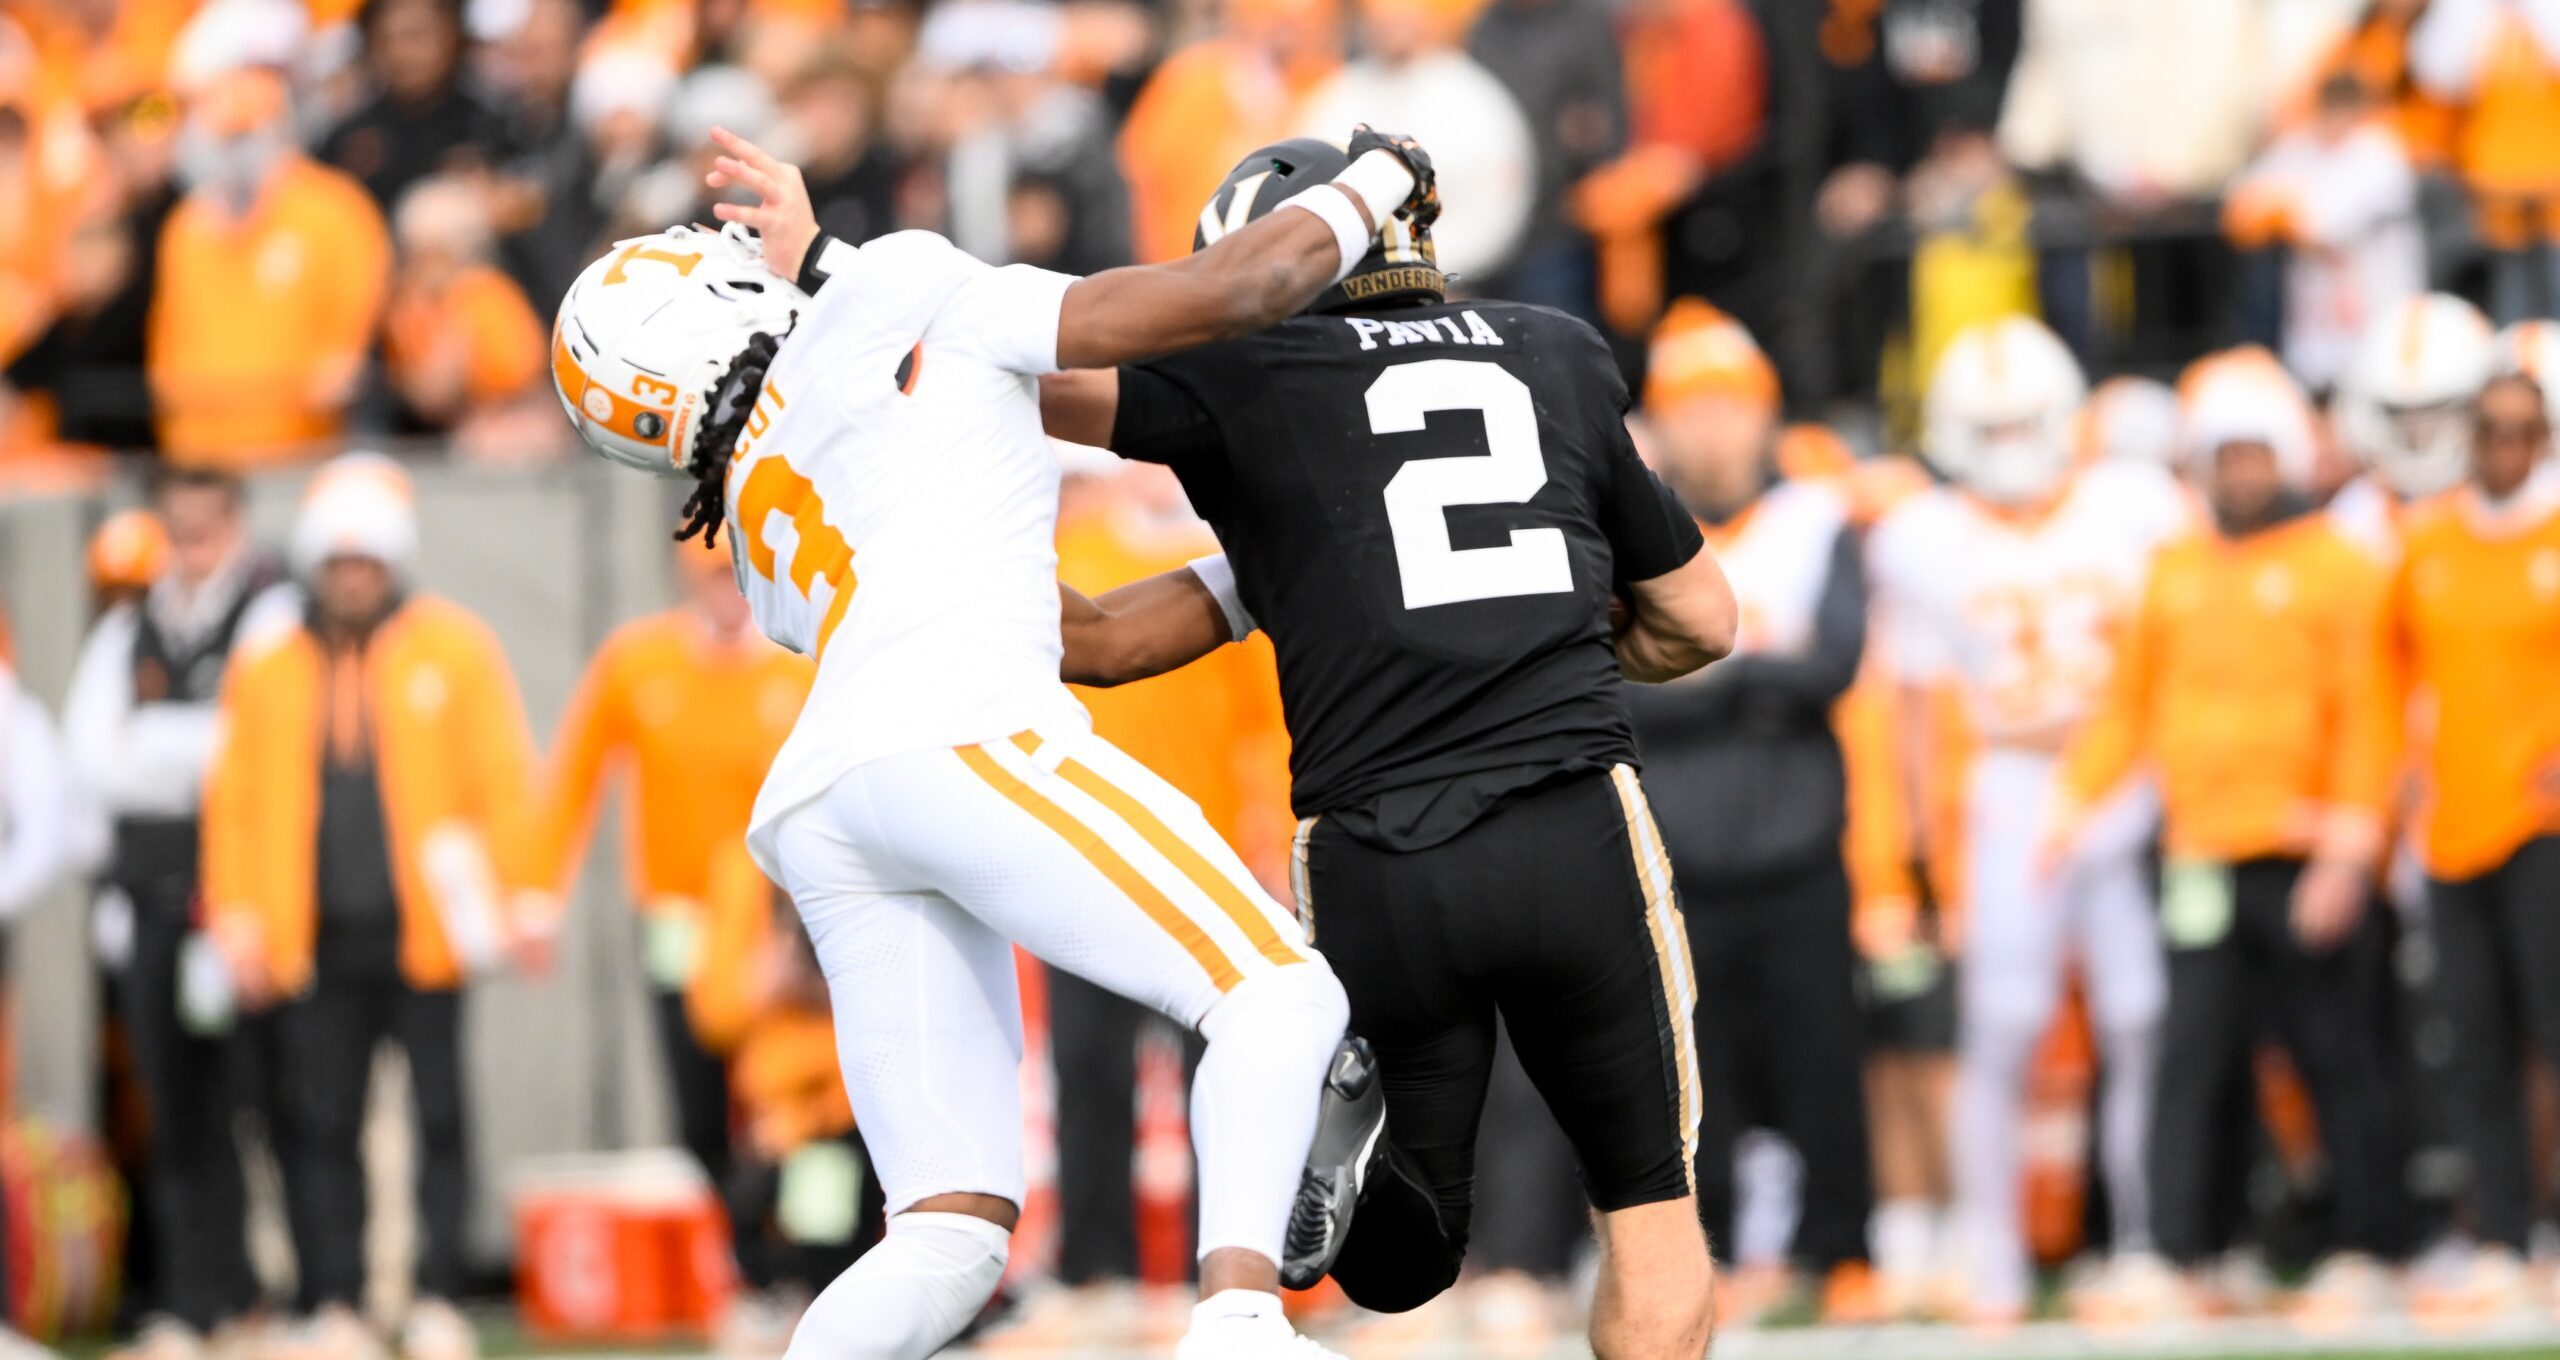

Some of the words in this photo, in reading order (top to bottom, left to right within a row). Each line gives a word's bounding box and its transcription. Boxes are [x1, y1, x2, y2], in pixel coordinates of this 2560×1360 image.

[1344, 310, 1504, 351] PAVIA
[632, 374, 677, 406] 3
[1364, 358, 1575, 610] 2
